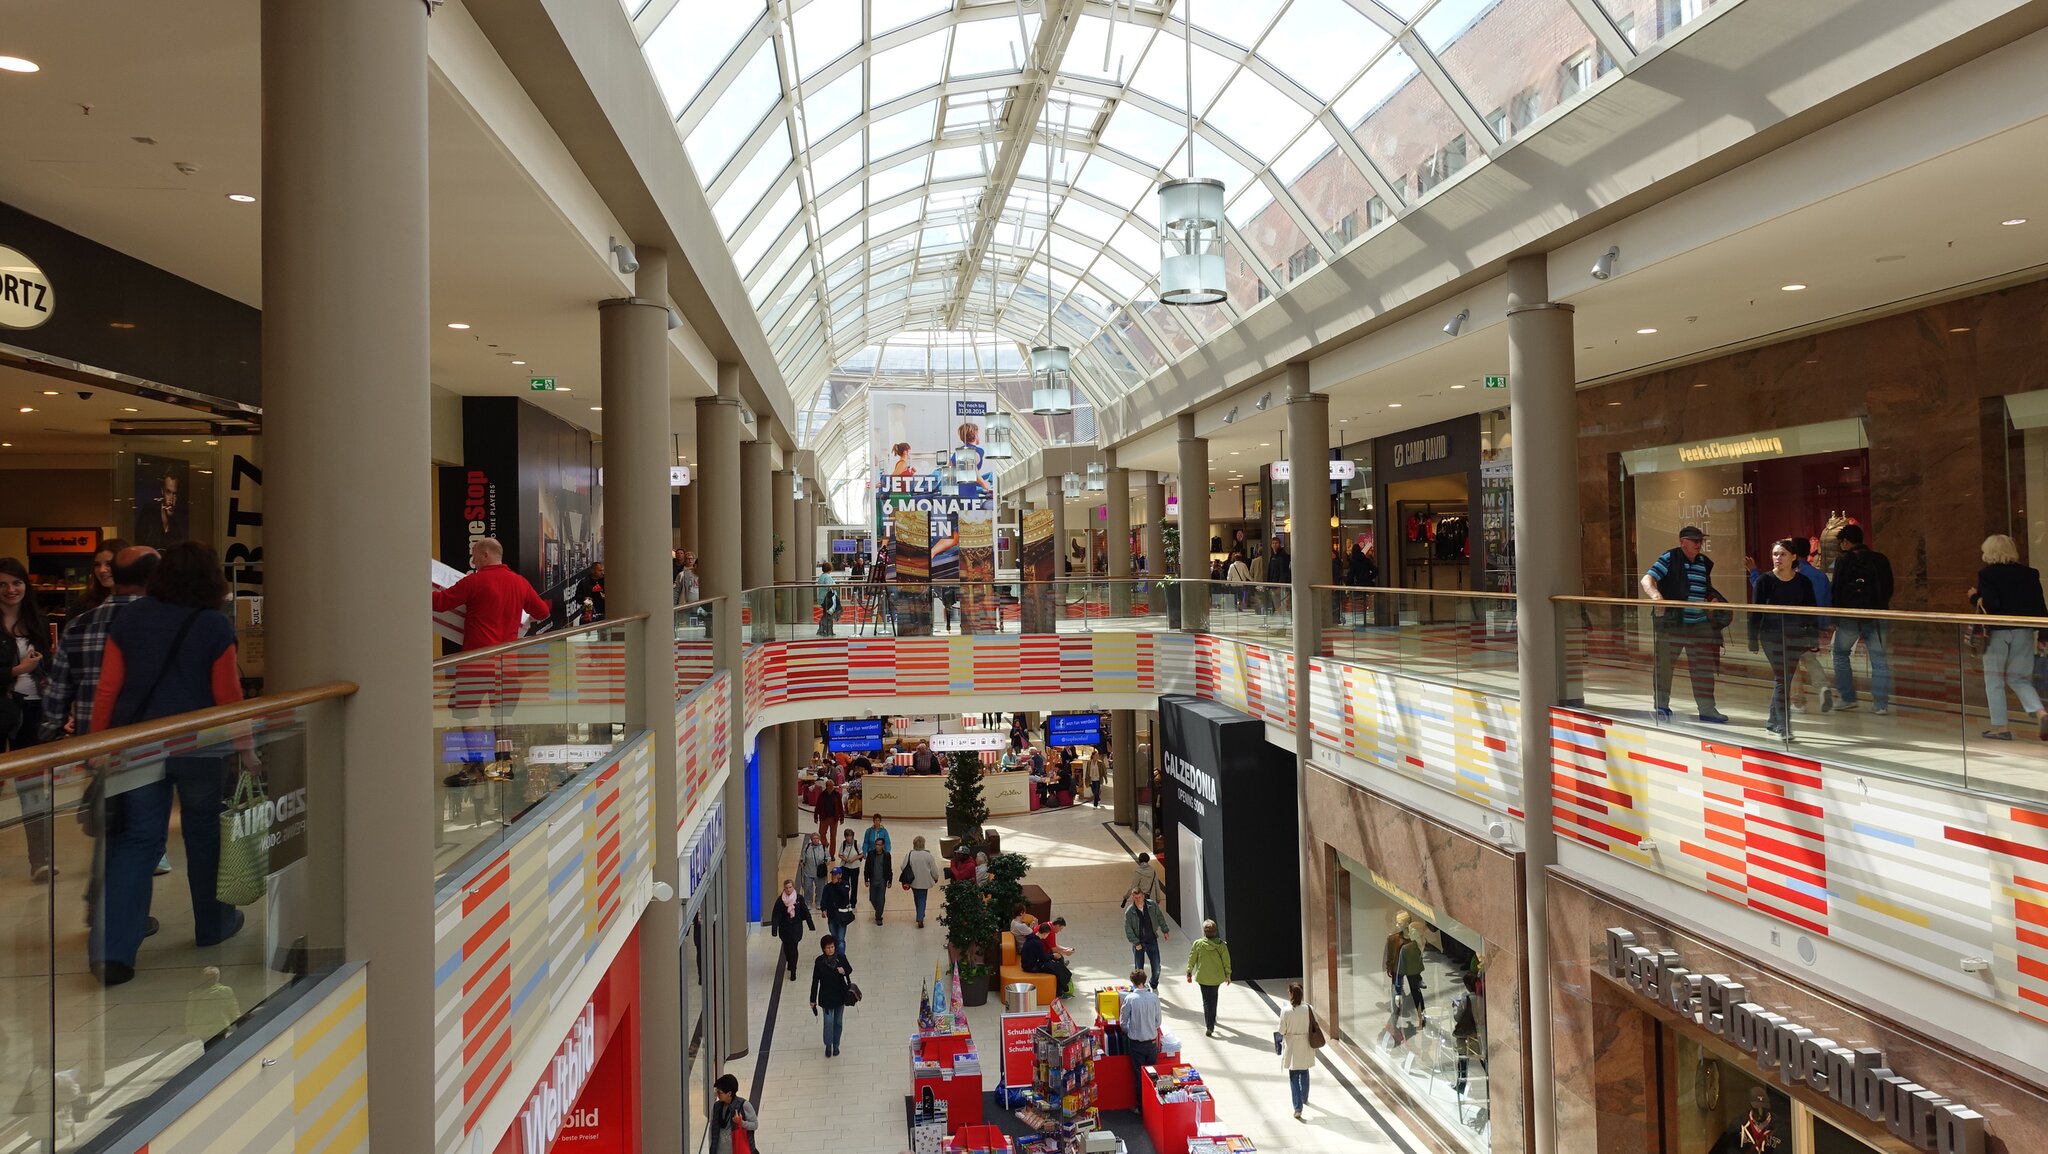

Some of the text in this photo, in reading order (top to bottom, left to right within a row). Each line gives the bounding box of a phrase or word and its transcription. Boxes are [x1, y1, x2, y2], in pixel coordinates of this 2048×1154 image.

[0, 273, 47, 312] RTZ
[1405, 435, 1446, 465] CAMP DAVID
[882, 477, 936, 493] JETZT
[882, 499, 893, 515] 6
[1678, 504, 1710, 519] ULTRA
[224, 455, 263, 597] RTZ
[1164, 750, 1218, 806] CALZEDONIA
[1177, 788, 1205, 817] OPENING SOON
[1007, 1028, 1037, 1036] Schulakti
[520, 1002, 595, 1154] Weltbild
